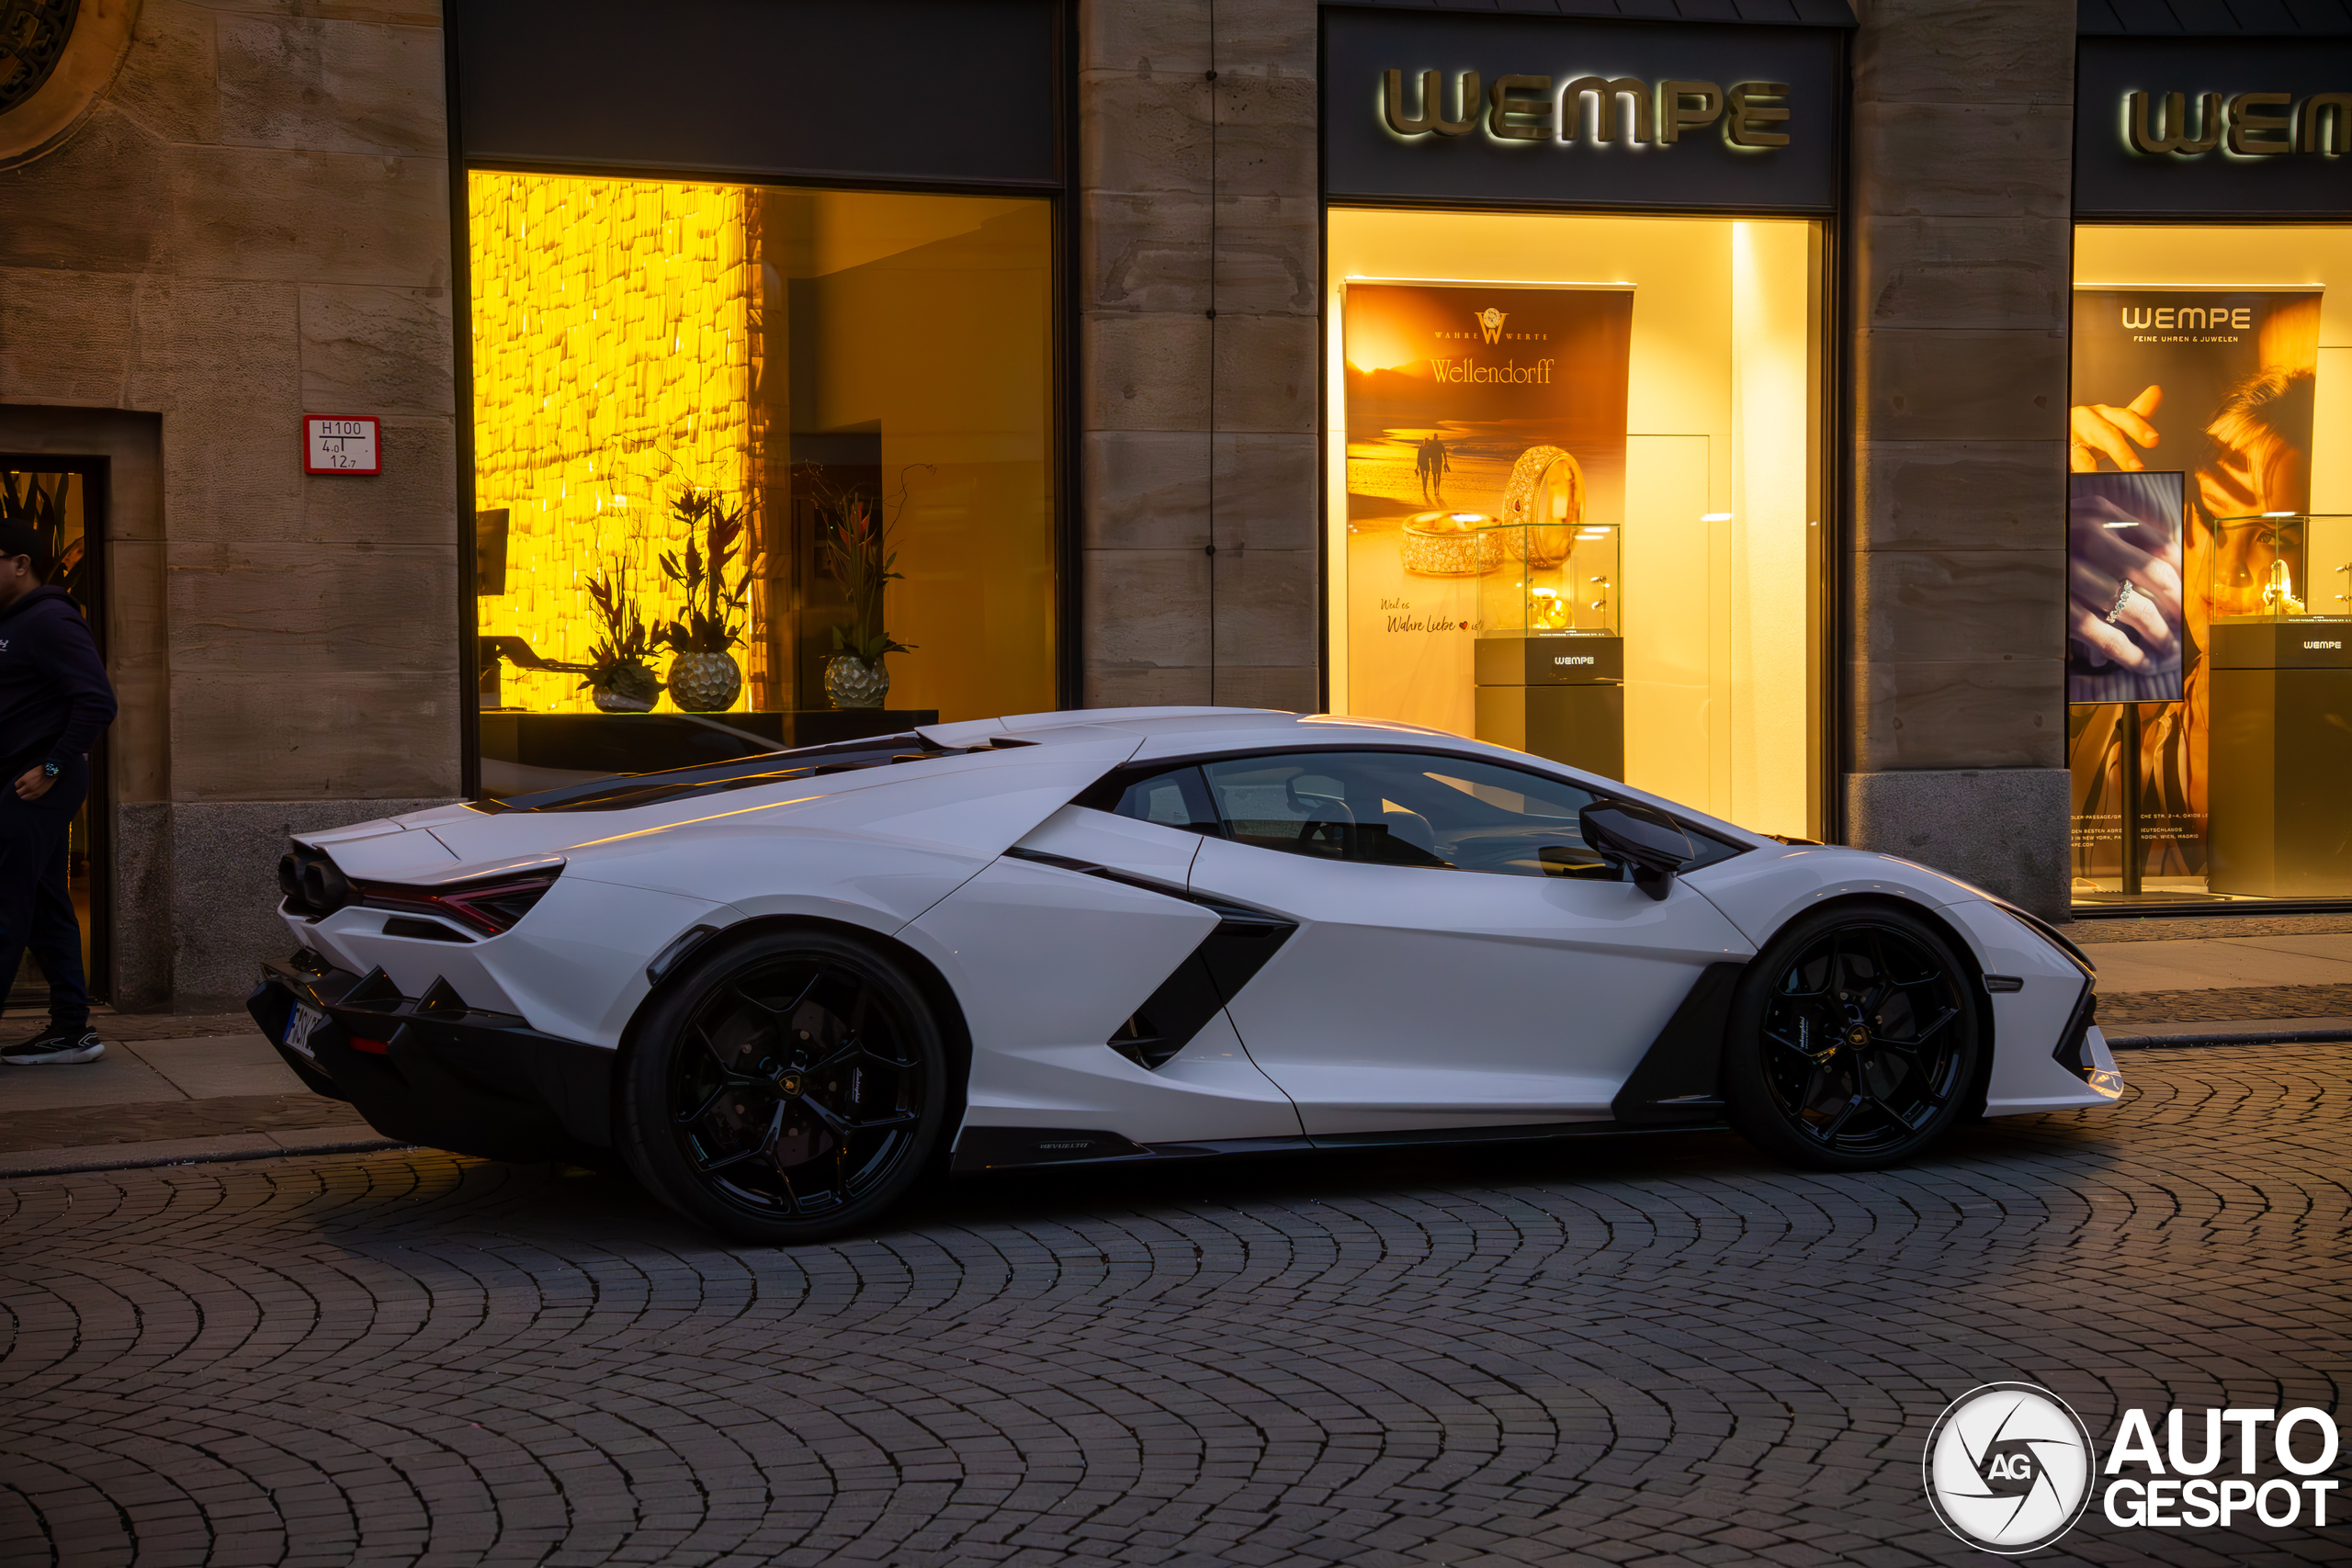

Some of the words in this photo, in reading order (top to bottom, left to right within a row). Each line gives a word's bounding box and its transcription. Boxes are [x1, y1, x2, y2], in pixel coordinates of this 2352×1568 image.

[1382, 67, 1791, 147] WEMPE
[2121, 307, 2251, 330] WEMPE
[1434, 331, 1478, 340] WAHRE
[1505, 333, 1549, 341] WERTE
[1430, 357, 1555, 384] Wellendorff
[322, 421, 361, 435] H100
[330, 455, 356, 468] 12.7
[1380, 597, 1400, 611] Weil
[1401, 602, 1410, 610] es
[1387, 615, 1425, 633] Wahre
[1426, 615, 1456, 633] Liebe
[2303, 640, 2342, 649] WEMPE
[1555, 656, 1595, 665] WEMPE
